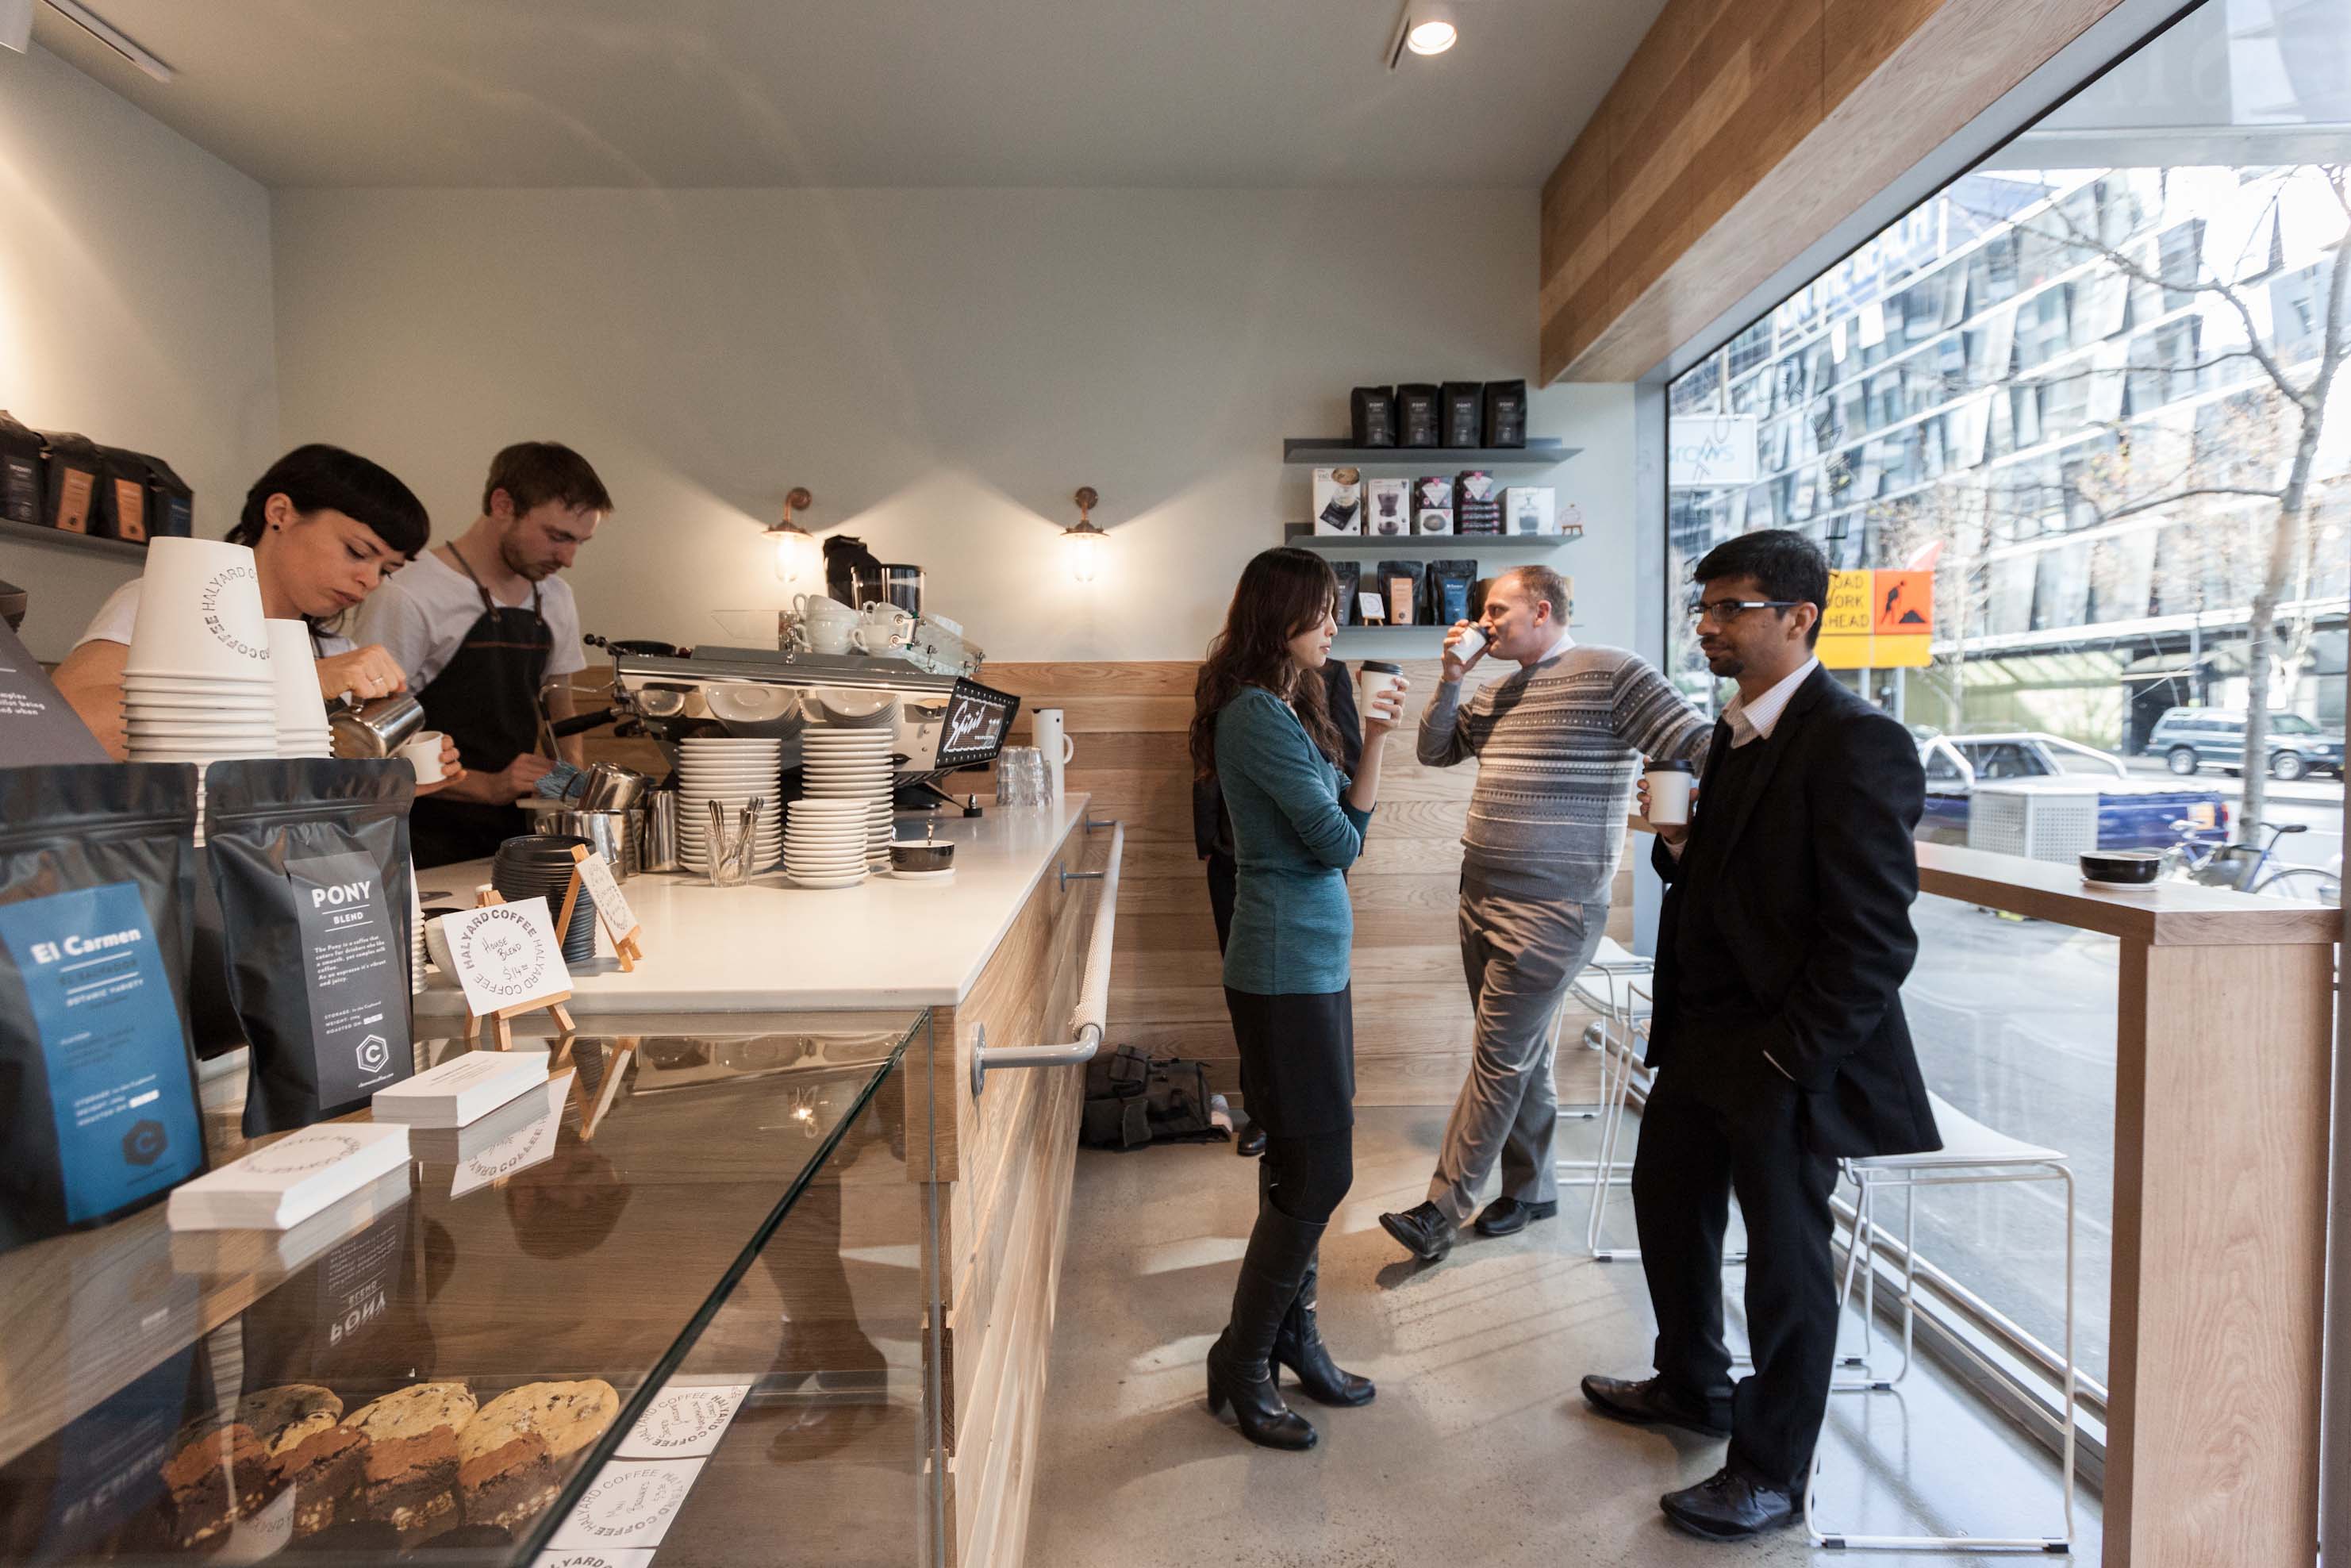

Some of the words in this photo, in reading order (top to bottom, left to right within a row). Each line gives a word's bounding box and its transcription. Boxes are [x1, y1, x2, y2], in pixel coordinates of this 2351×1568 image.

[201, 567, 245, 611] HALYARD
[1834, 575, 1864, 589] OAD
[1825, 615, 1869, 628] HEAD
[311, 880, 371, 909] PONY
[333, 912, 363, 925] BLEND
[30, 941, 61, 964] El
[63, 928, 142, 956] Carmen
[460, 913, 489, 969] HALYARD
[491, 909, 537, 938] COFFEE
[524, 939, 546, 989] HALYARD
[474, 973, 522, 996] COFFEE
